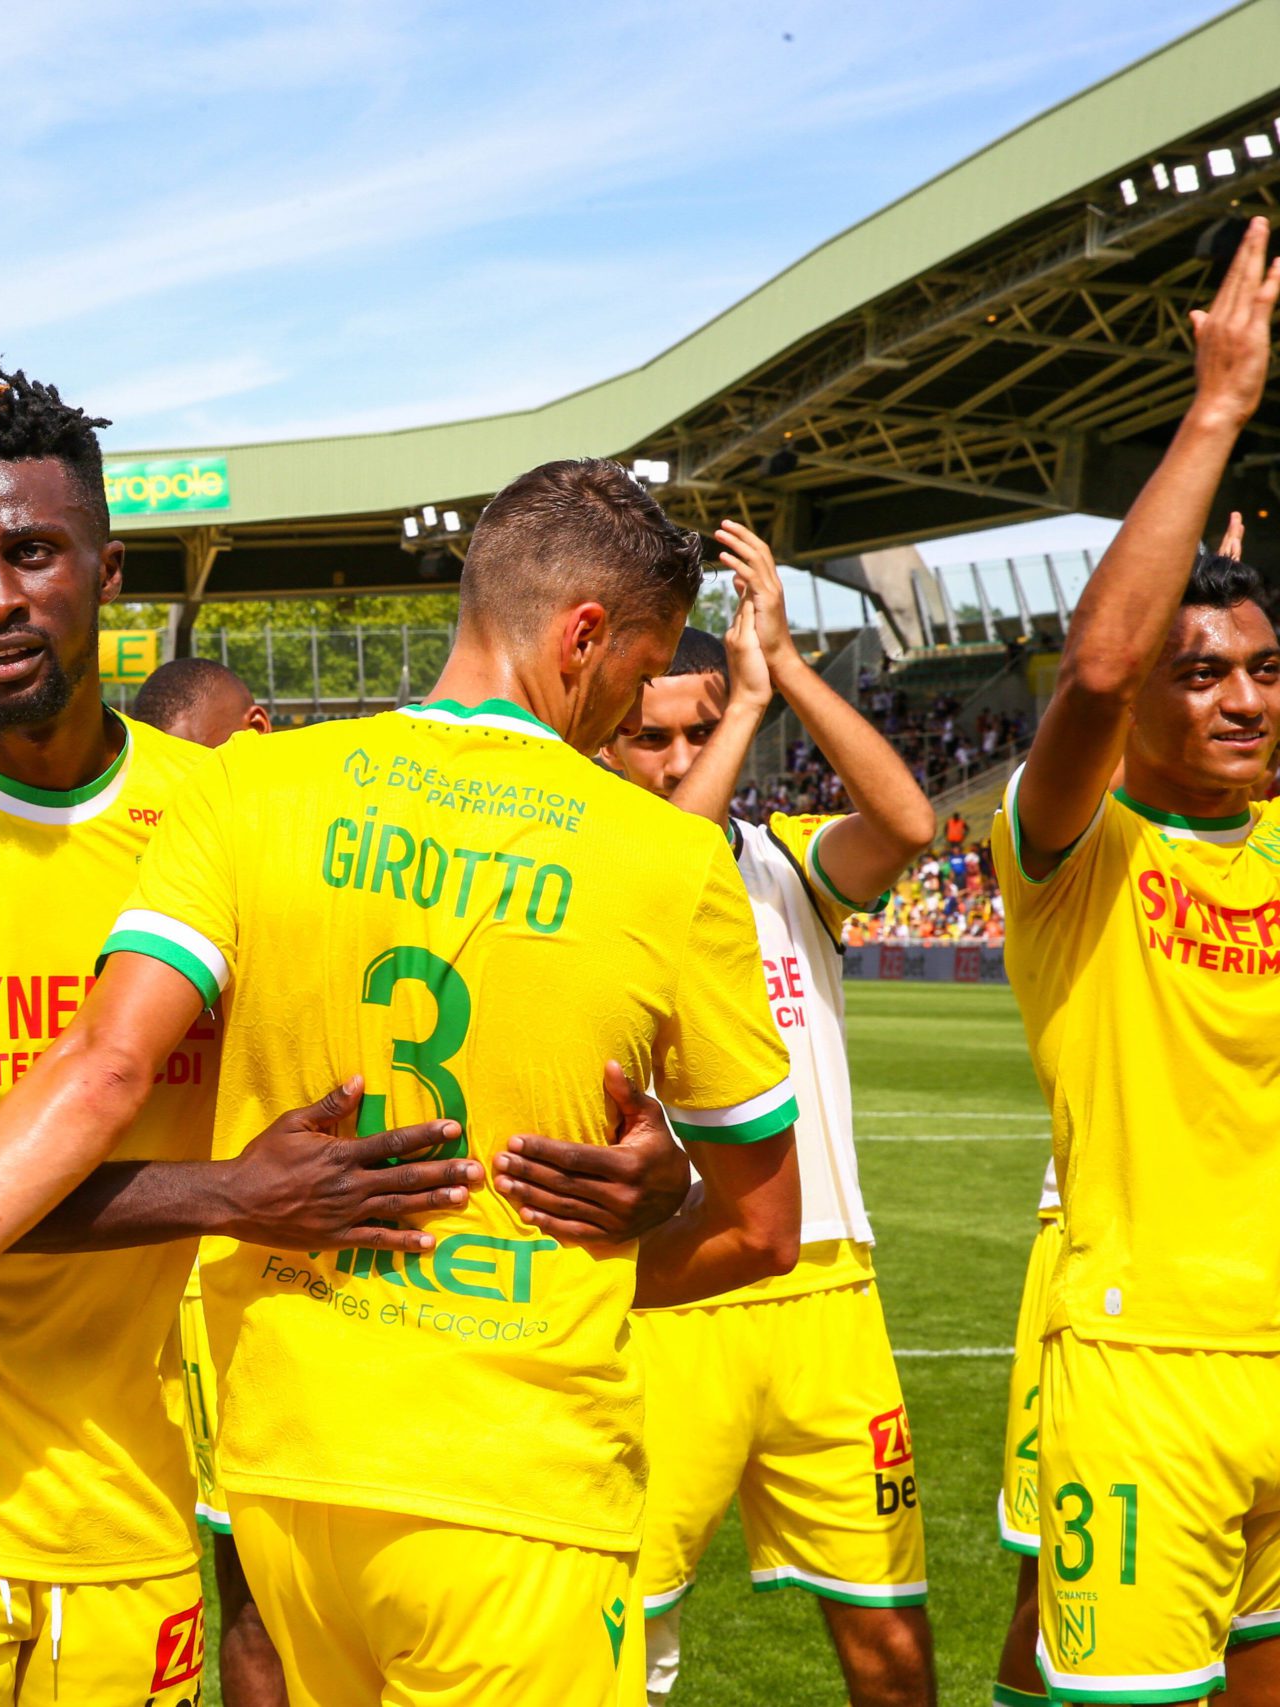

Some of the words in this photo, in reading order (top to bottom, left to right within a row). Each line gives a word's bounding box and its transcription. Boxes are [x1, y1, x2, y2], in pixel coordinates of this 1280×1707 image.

[387, 772, 422, 792] DU
[426, 789, 581, 833] PATRIMOINE
[392, 756, 586, 815] PRÉSERVATION
[356, 946, 471, 1168] 3
[261, 1255, 369, 1320] Fenêtres
[380, 1301, 406, 1327] et
[1056, 1482, 1138, 1586] 31
